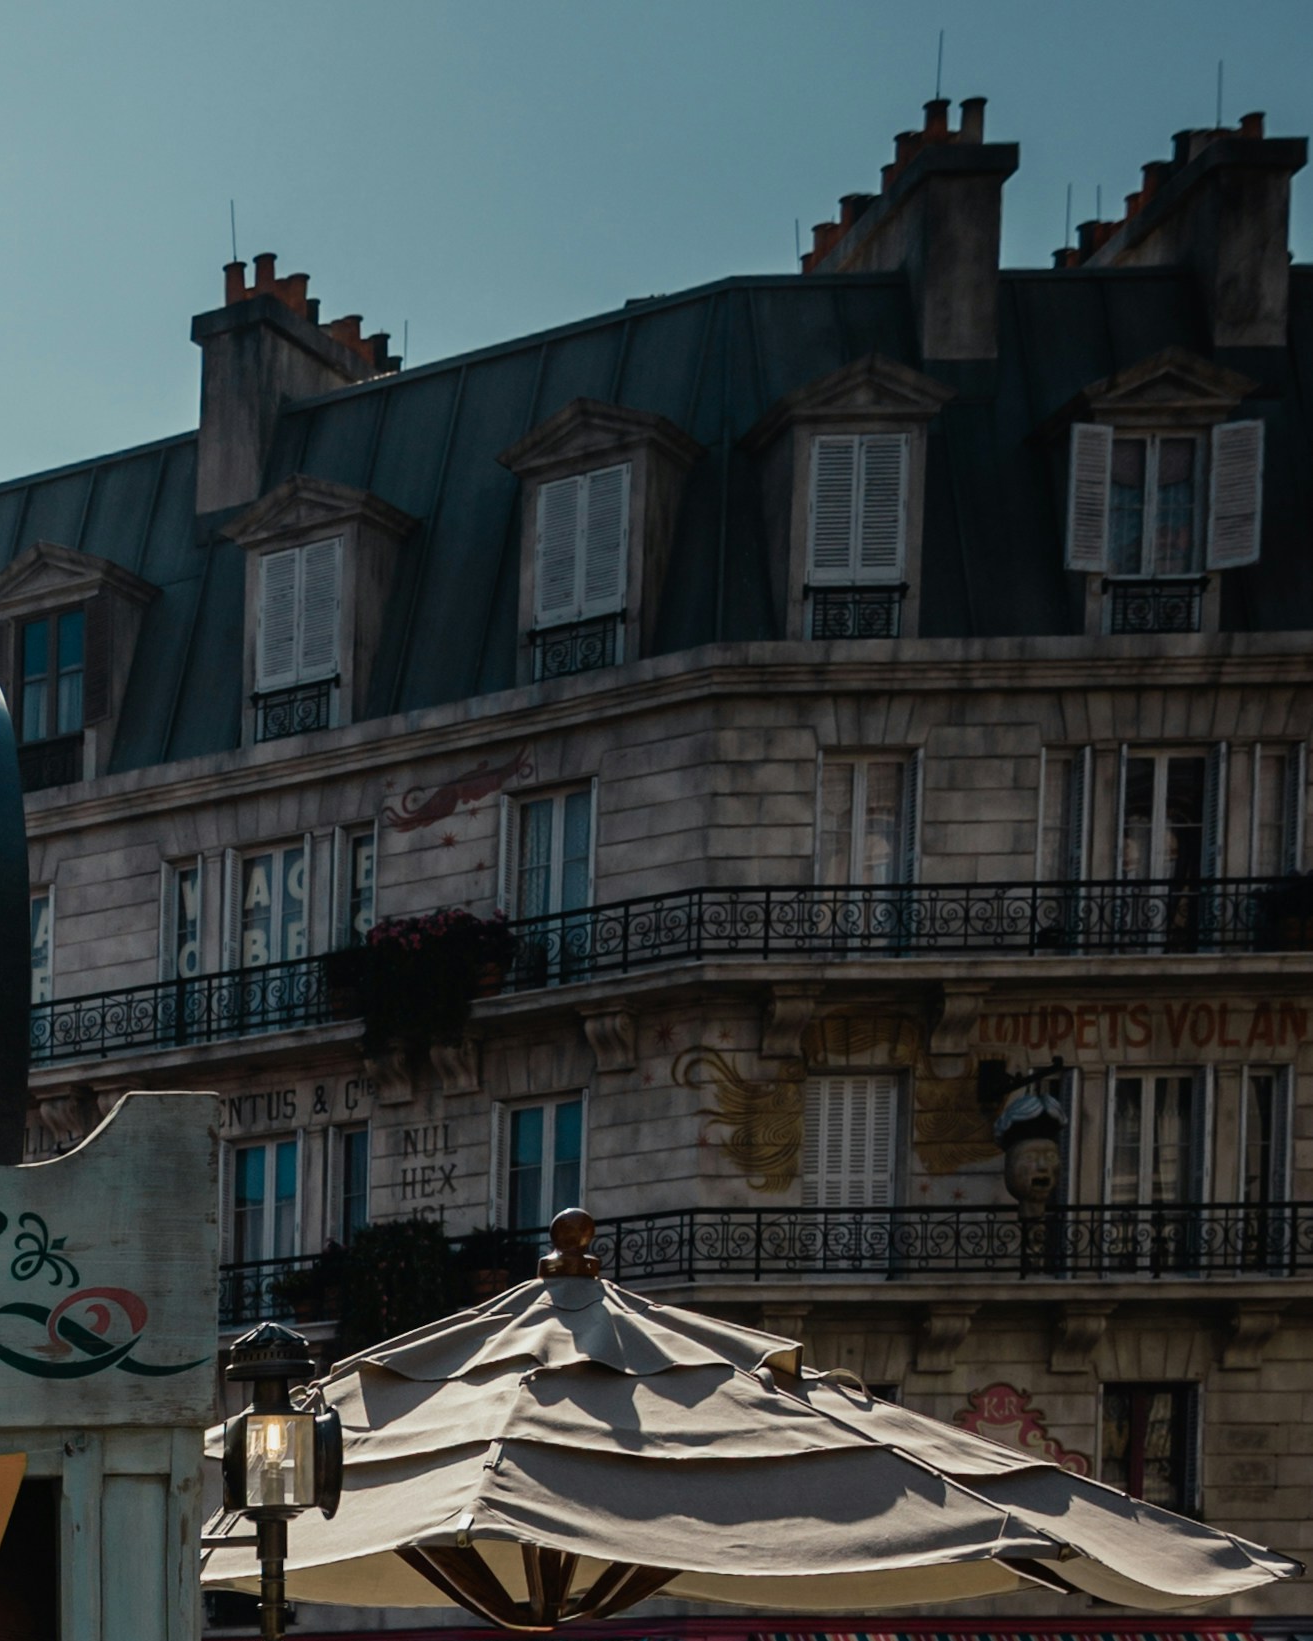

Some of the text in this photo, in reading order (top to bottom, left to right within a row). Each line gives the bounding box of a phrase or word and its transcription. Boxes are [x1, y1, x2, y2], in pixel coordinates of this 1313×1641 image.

[313, 1085, 328, 1115] &
[403, 1123, 457, 1160] NUL
[401, 1163, 457, 1201] HEX
